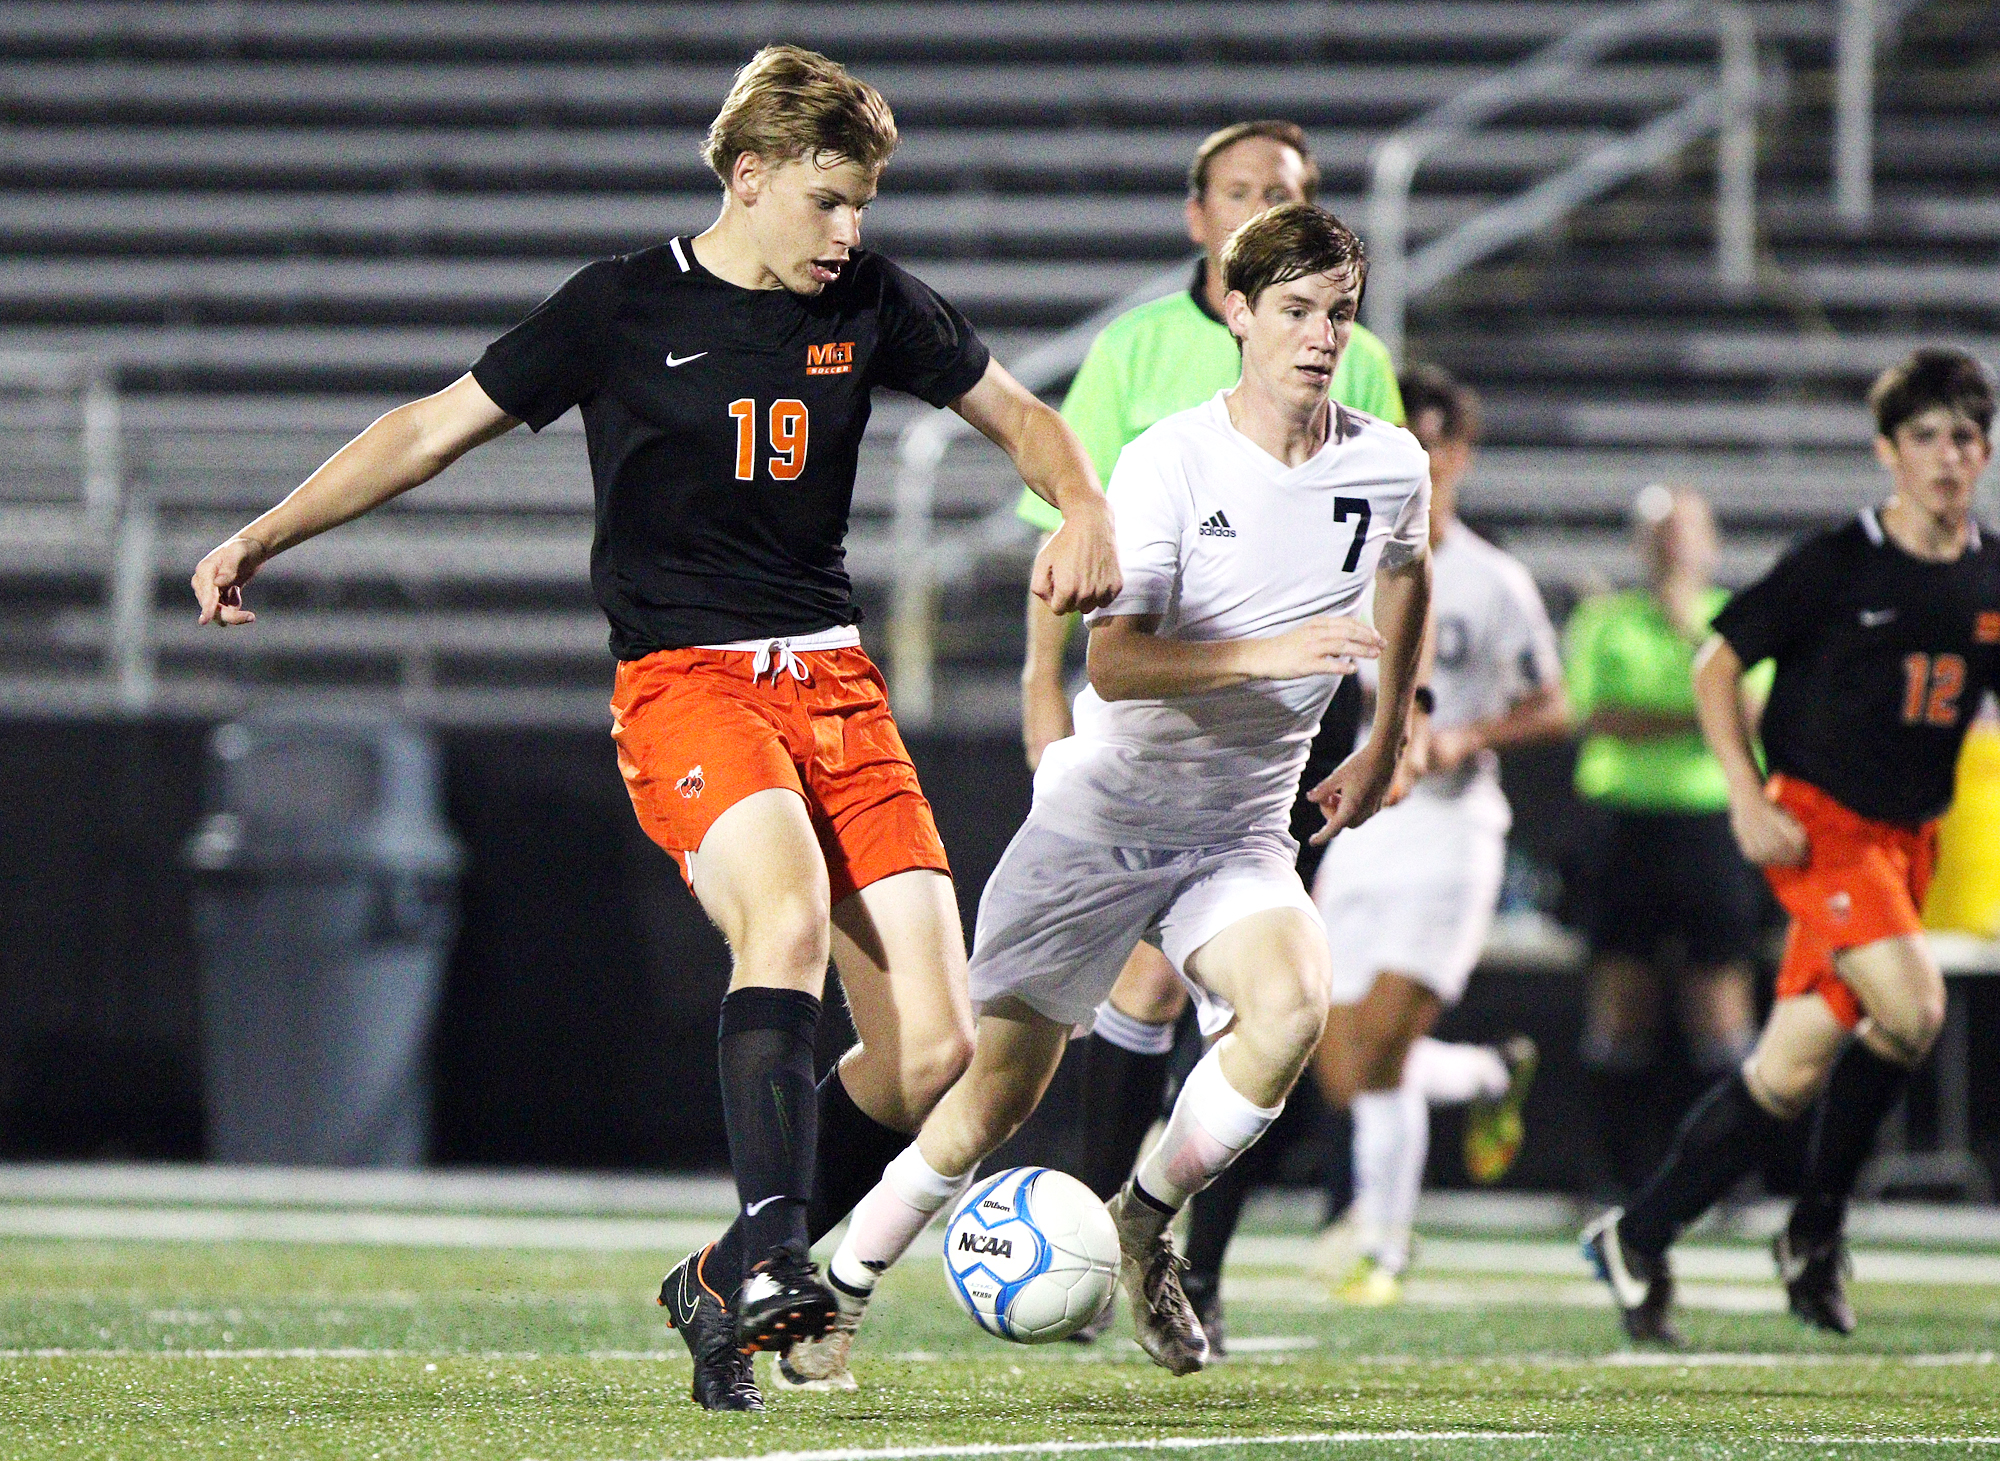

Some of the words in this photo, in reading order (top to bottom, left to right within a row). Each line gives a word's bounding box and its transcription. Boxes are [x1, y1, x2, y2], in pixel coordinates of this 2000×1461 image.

[811, 365, 849, 374] SOCCER
[729, 398, 808, 480] 19
[1333, 497, 1371, 573] 7
[1903, 652, 1966, 725] 12
[983, 1201, 1010, 1212] Wilson
[958, 1232, 1013, 1259] NCAA
